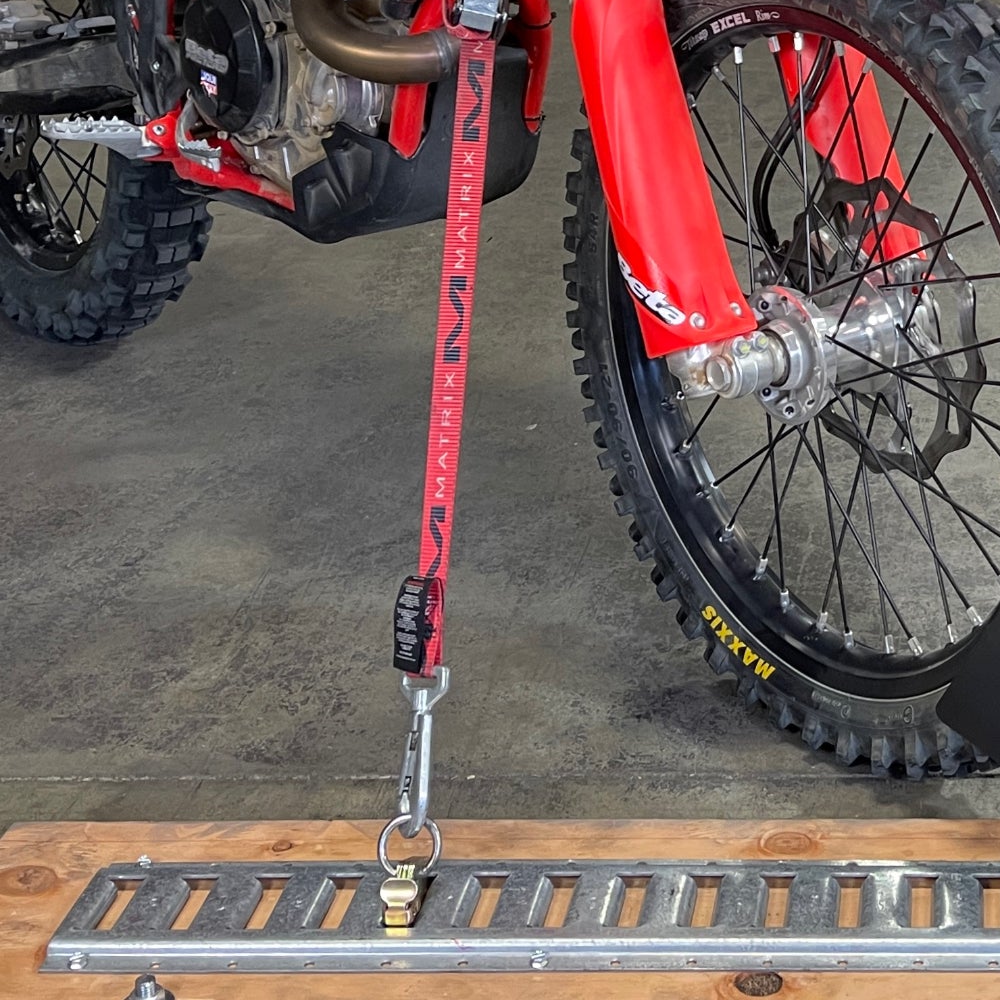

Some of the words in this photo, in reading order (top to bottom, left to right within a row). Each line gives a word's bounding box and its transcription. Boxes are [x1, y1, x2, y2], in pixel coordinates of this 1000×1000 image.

[184, 37, 230, 76] Beta
[709, 11, 751, 35] EXCEL
[453, 151, 476, 269] MATRIX
[617, 252, 687, 326] Beta
[434, 371, 456, 499] MATRIX
[701, 604, 777, 680] MAXXIS
